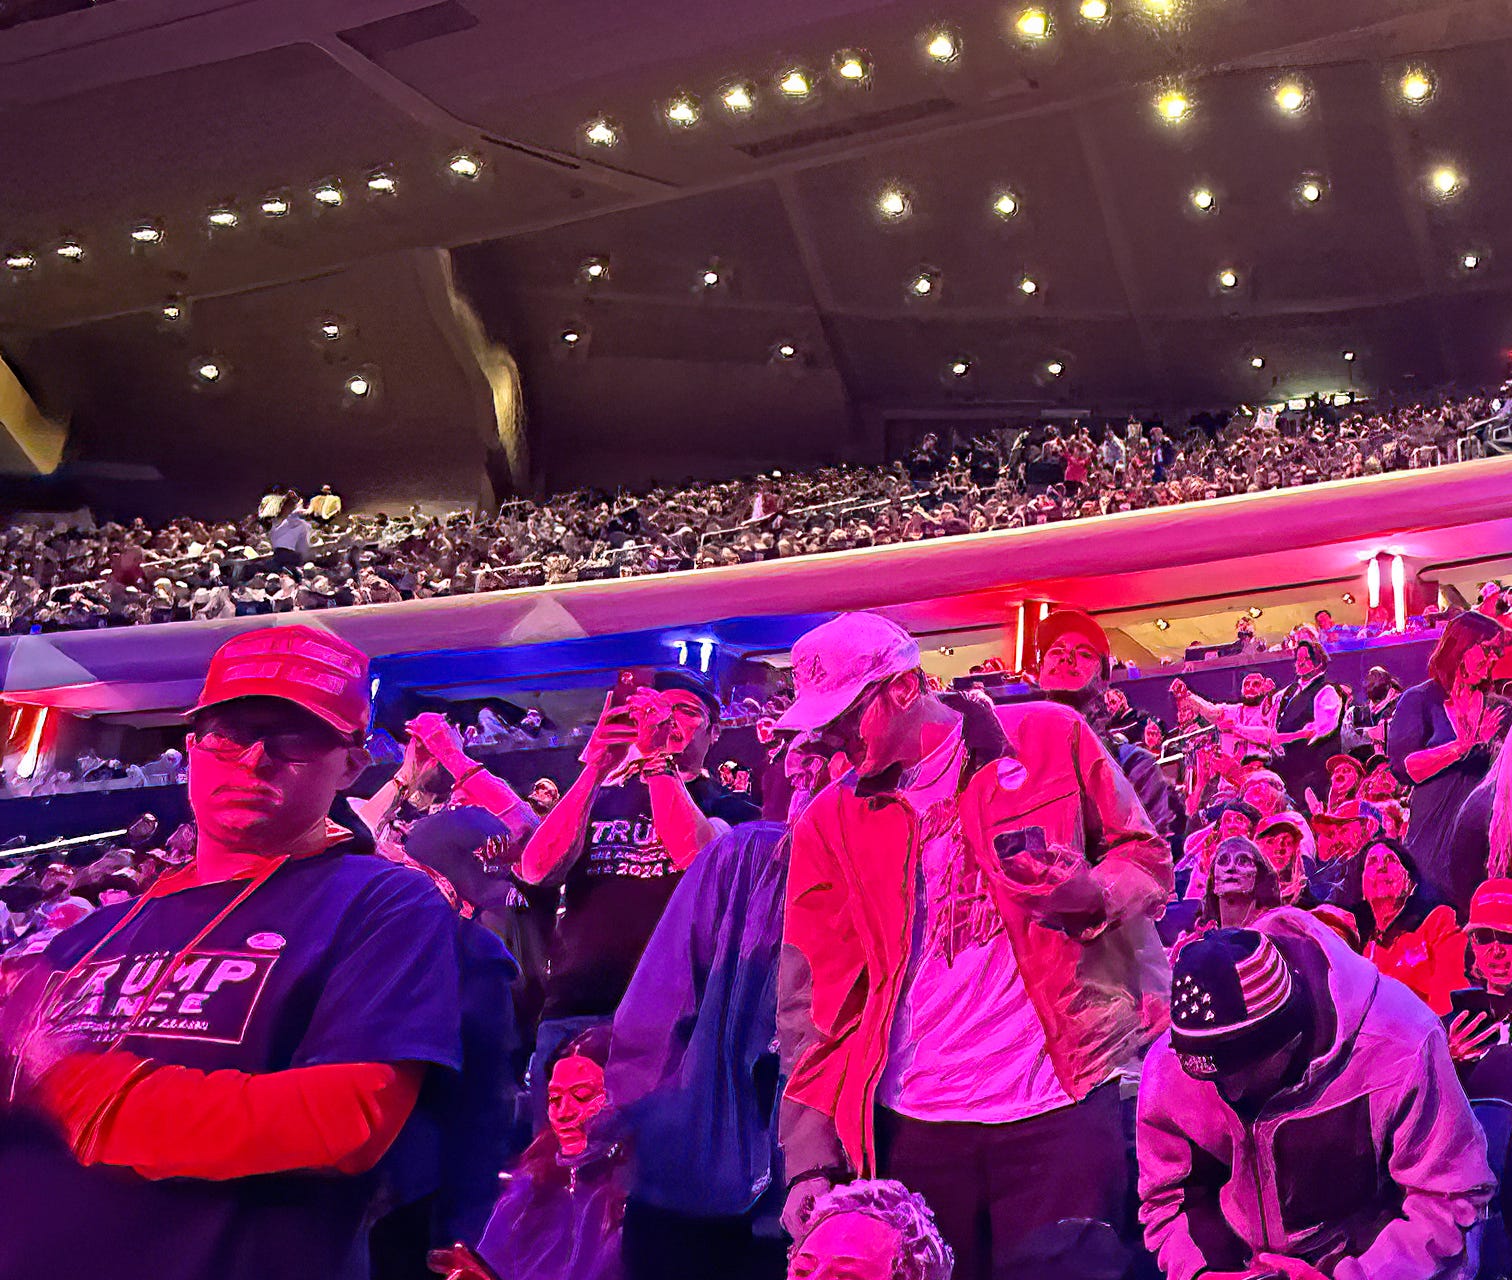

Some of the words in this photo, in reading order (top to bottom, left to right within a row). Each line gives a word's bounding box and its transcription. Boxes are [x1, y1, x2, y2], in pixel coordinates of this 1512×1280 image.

[591, 819, 658, 845] TRU
[66, 957, 257, 999] RUMP
[52, 991, 210, 1019] ANCE
